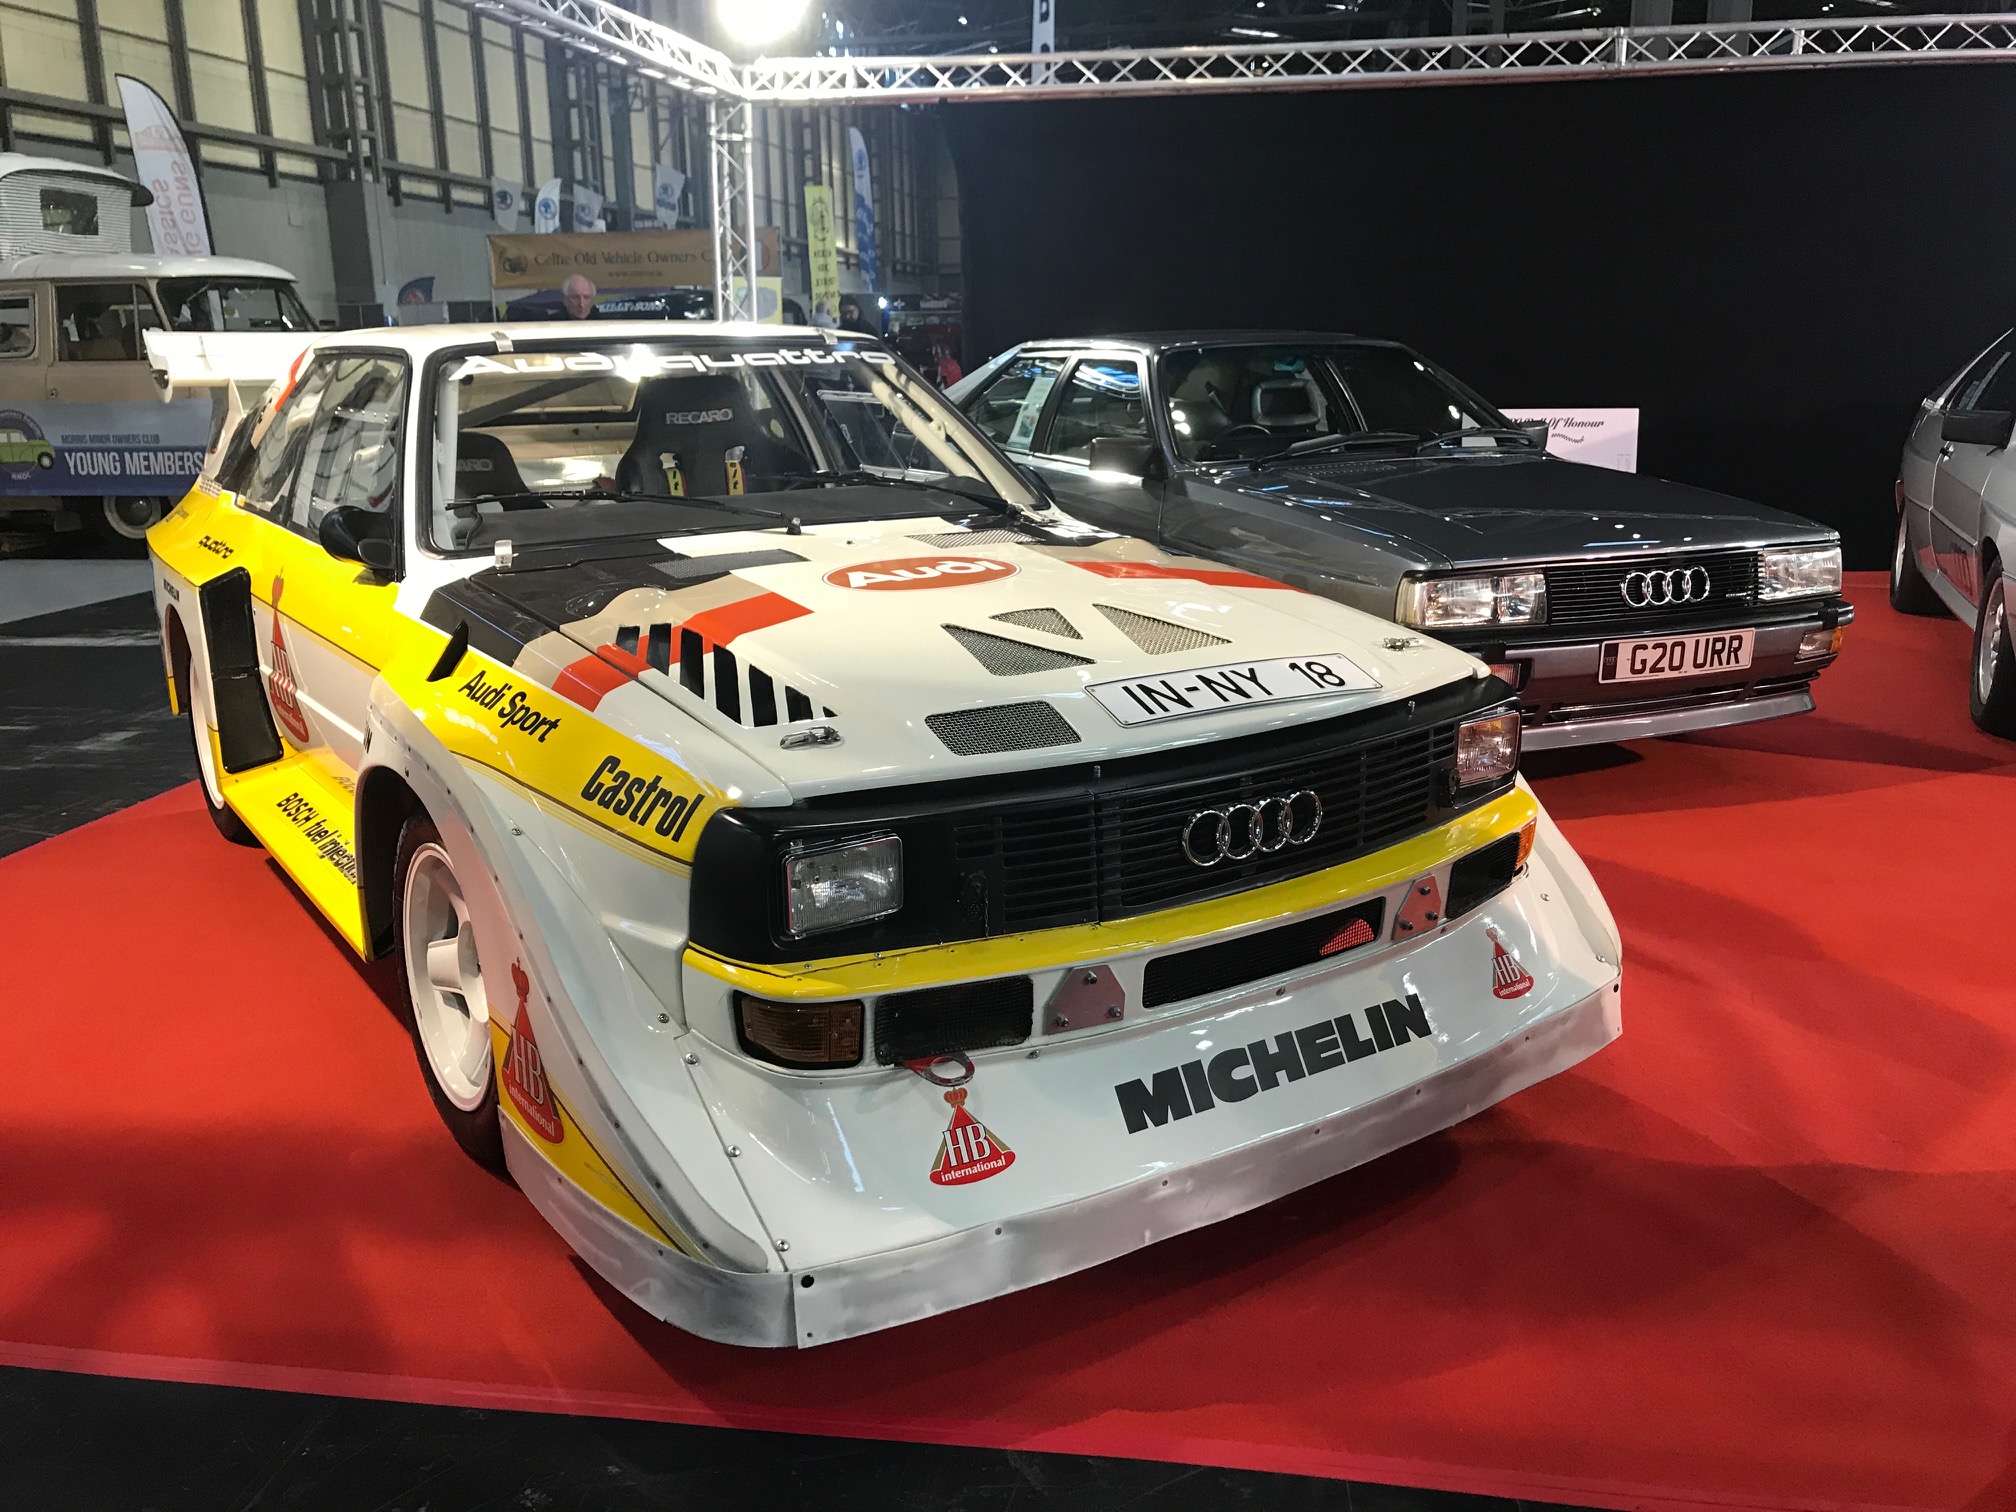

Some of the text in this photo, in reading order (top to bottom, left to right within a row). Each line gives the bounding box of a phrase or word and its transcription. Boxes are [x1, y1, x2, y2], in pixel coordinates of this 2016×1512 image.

[534, 251, 571, 267] Celtic
[574, 251, 597, 266] Old
[601, 251, 643, 265] Vehicle
[647, 251, 698, 264] Owners
[448, 348, 897, 381] Audi quattro
[665, 408, 734, 425] RECARO
[1563, 417, 1605, 428] Honour
[61, 434, 160, 445] MORRIS MINOR OWNERS CLUB
[64, 451, 204, 476] YOUNG MEMBERS
[197, 535, 234, 559] quattro
[846, 560, 1007, 589] Audi
[1629, 634, 1744, 675] G20 URR
[1121, 661, 1346, 715] IN-NY 18
[458, 670, 563, 743] Audi Sport
[580, 755, 705, 843] Castrol
[276, 792, 320, 828] BOSCH
[302, 818, 339, 845] fuel
[1491, 952, 1521, 986] HB
[1498, 978, 1531, 997] international
[510, 1023, 545, 1107] HB
[1114, 993, 1432, 1135] MICHELIN
[508, 1080, 555, 1138] international
[942, 1121, 991, 1167] HB
[941, 1155, 1006, 1183] international
